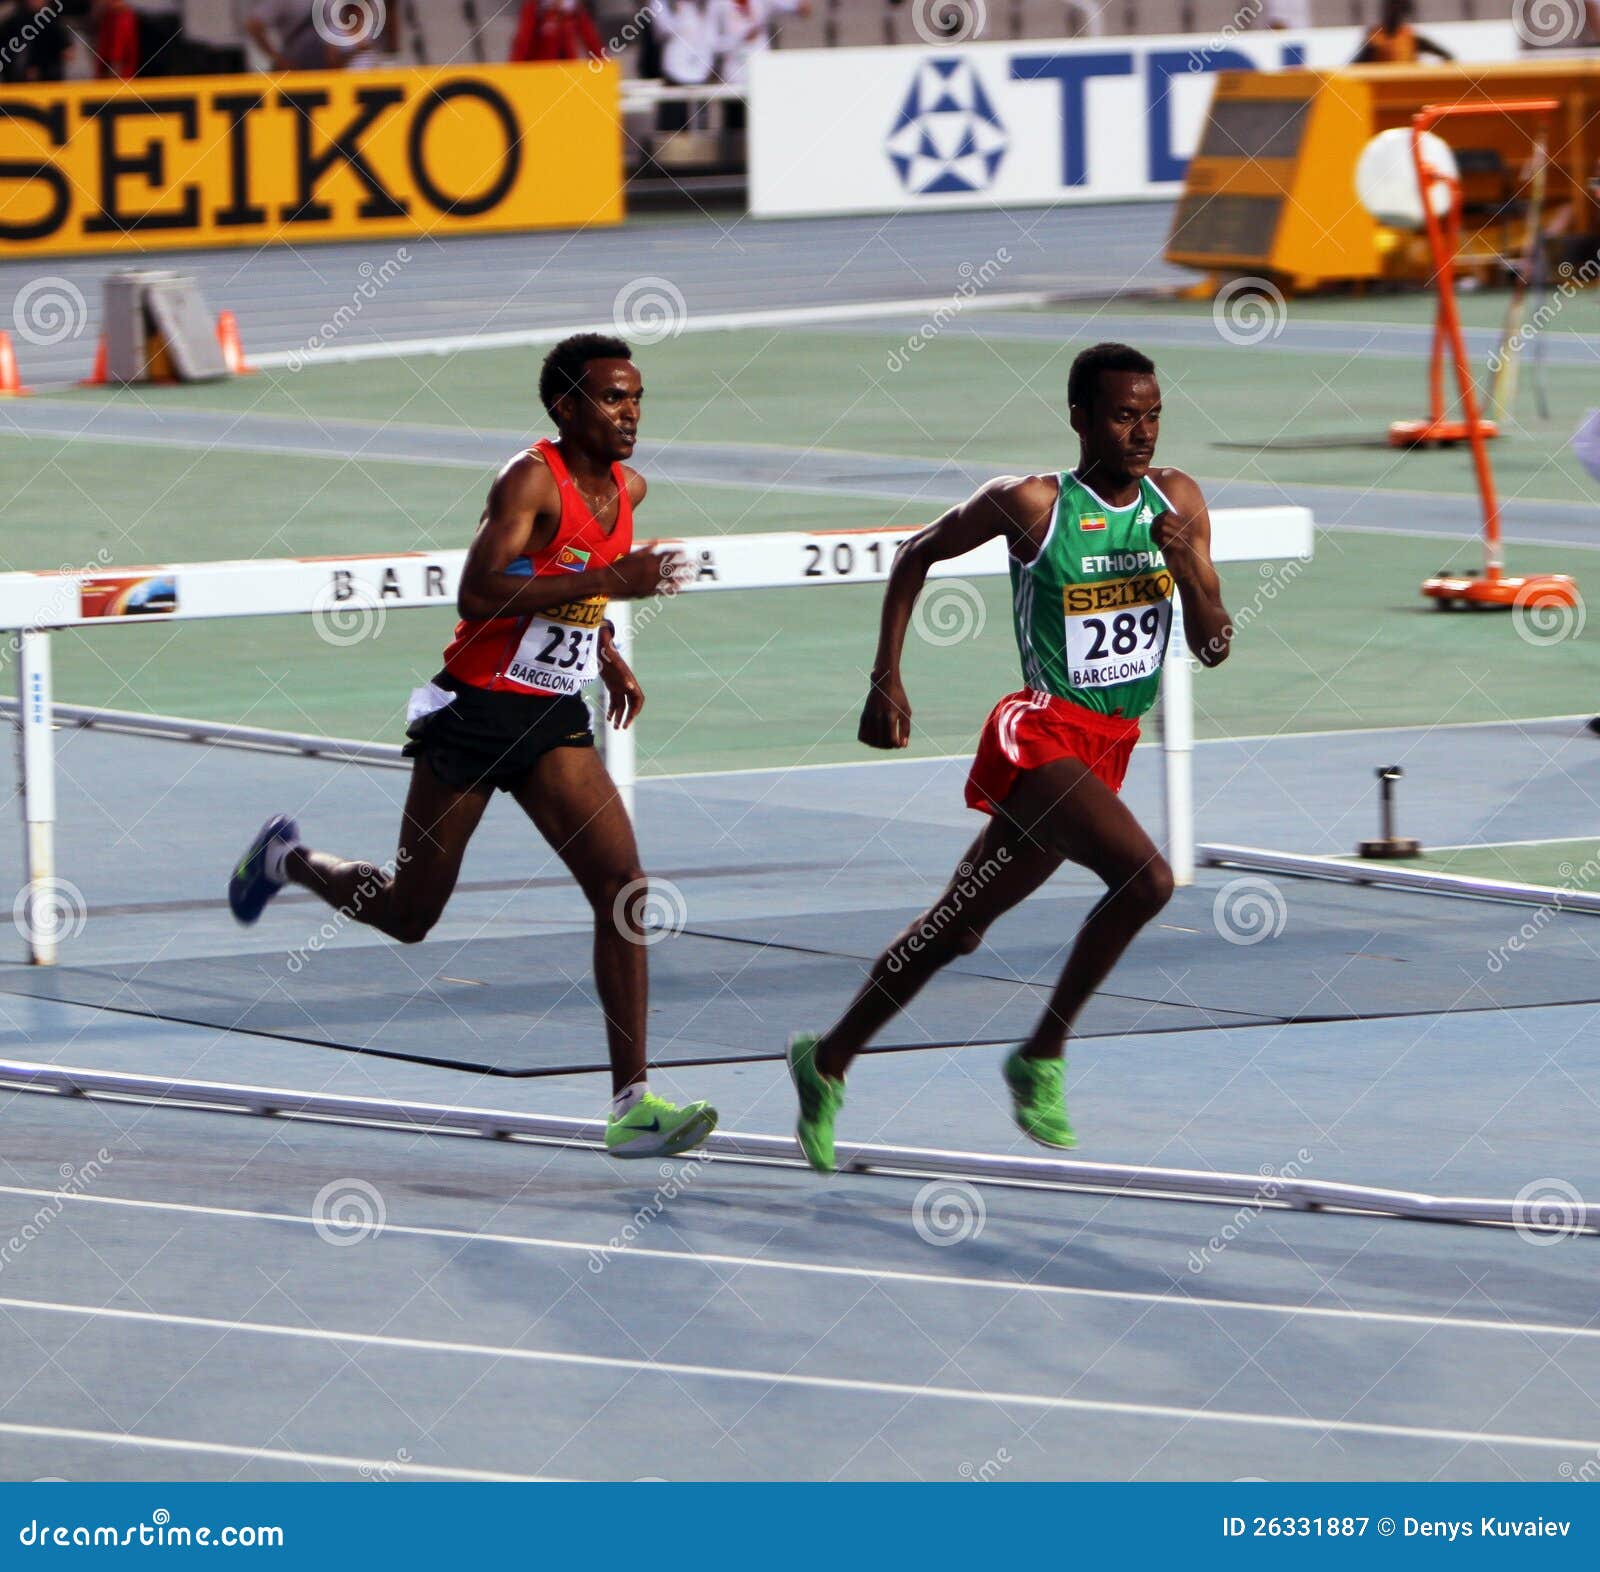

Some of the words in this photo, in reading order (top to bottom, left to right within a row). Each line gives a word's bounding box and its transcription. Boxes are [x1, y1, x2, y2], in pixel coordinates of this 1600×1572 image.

[1009, 44, 1305, 187] TD
[0, 78, 523, 241] SEIKO
[804, 540, 903, 576] 201
[1081, 550, 1166, 574] ETHIOPIA
[1068, 574, 1171, 612] SEIKO
[1082, 607, 1160, 660] 289
[510, 663, 574, 692] BARCELONA
[1073, 660, 1146, 685] BARCELONA
